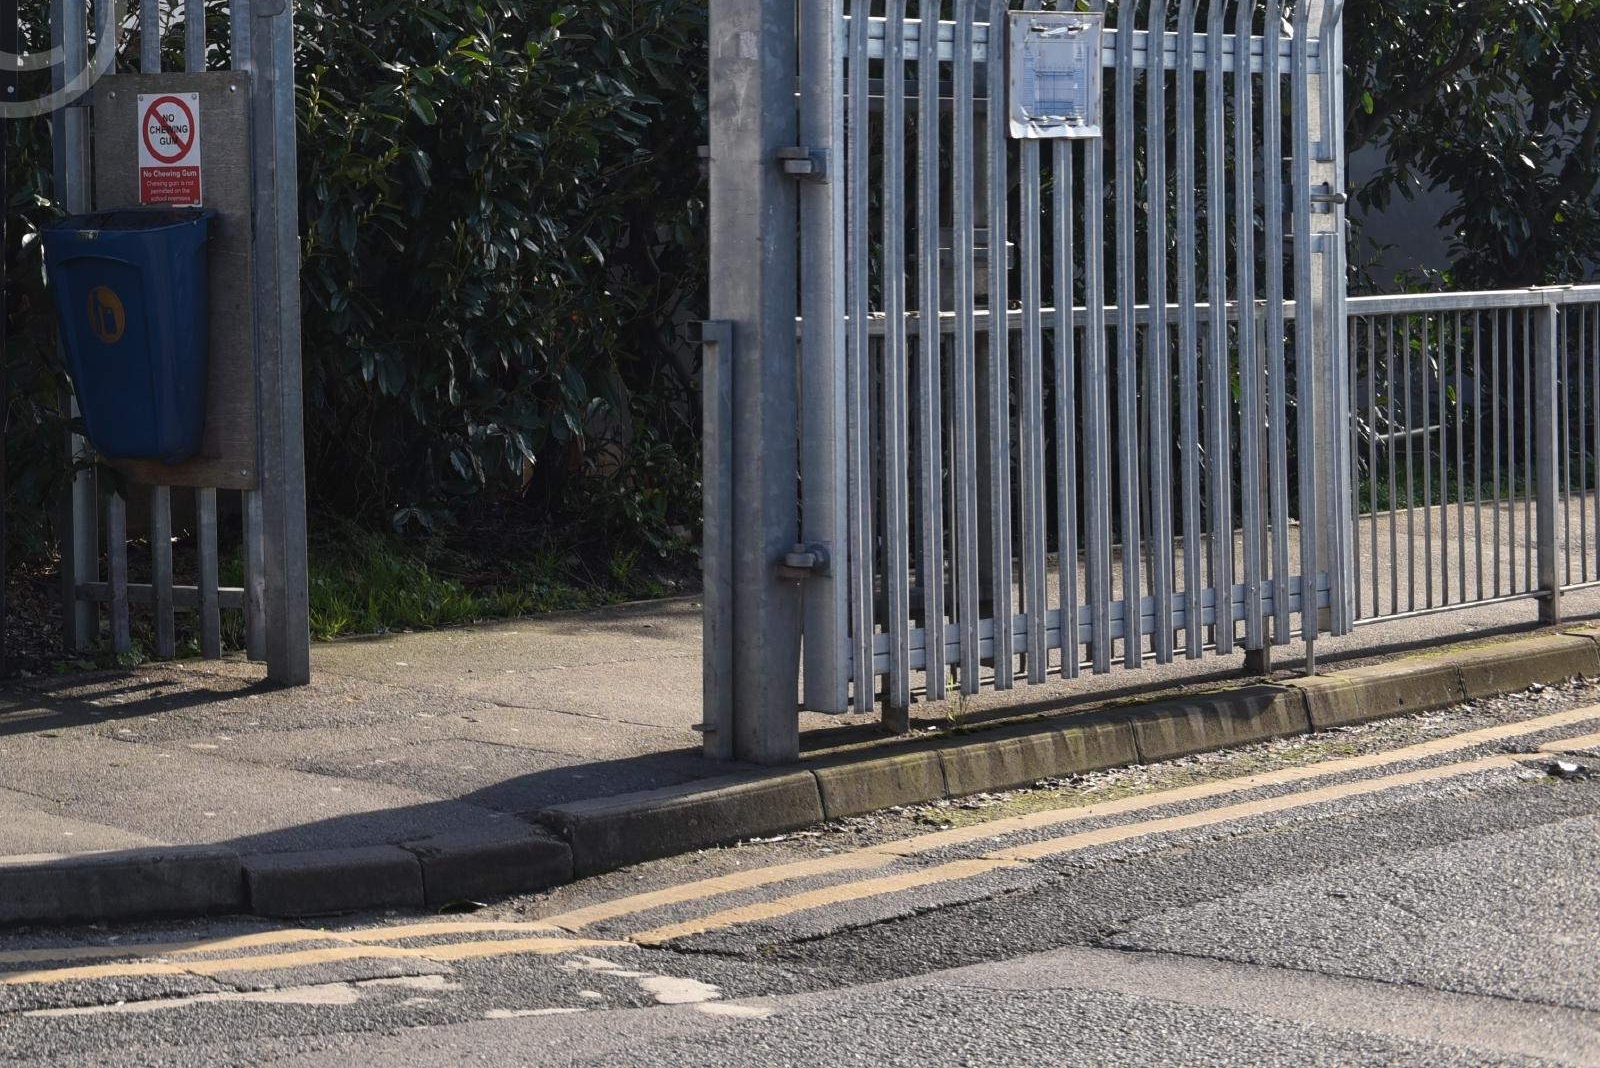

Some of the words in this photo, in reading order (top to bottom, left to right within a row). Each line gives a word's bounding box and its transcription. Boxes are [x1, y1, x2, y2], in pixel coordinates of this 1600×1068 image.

[162, 113, 175, 123] NO
[143, 170, 152, 178] No
[153, 169, 181, 179] Chewing
[182, 169, 197, 177] Gum
